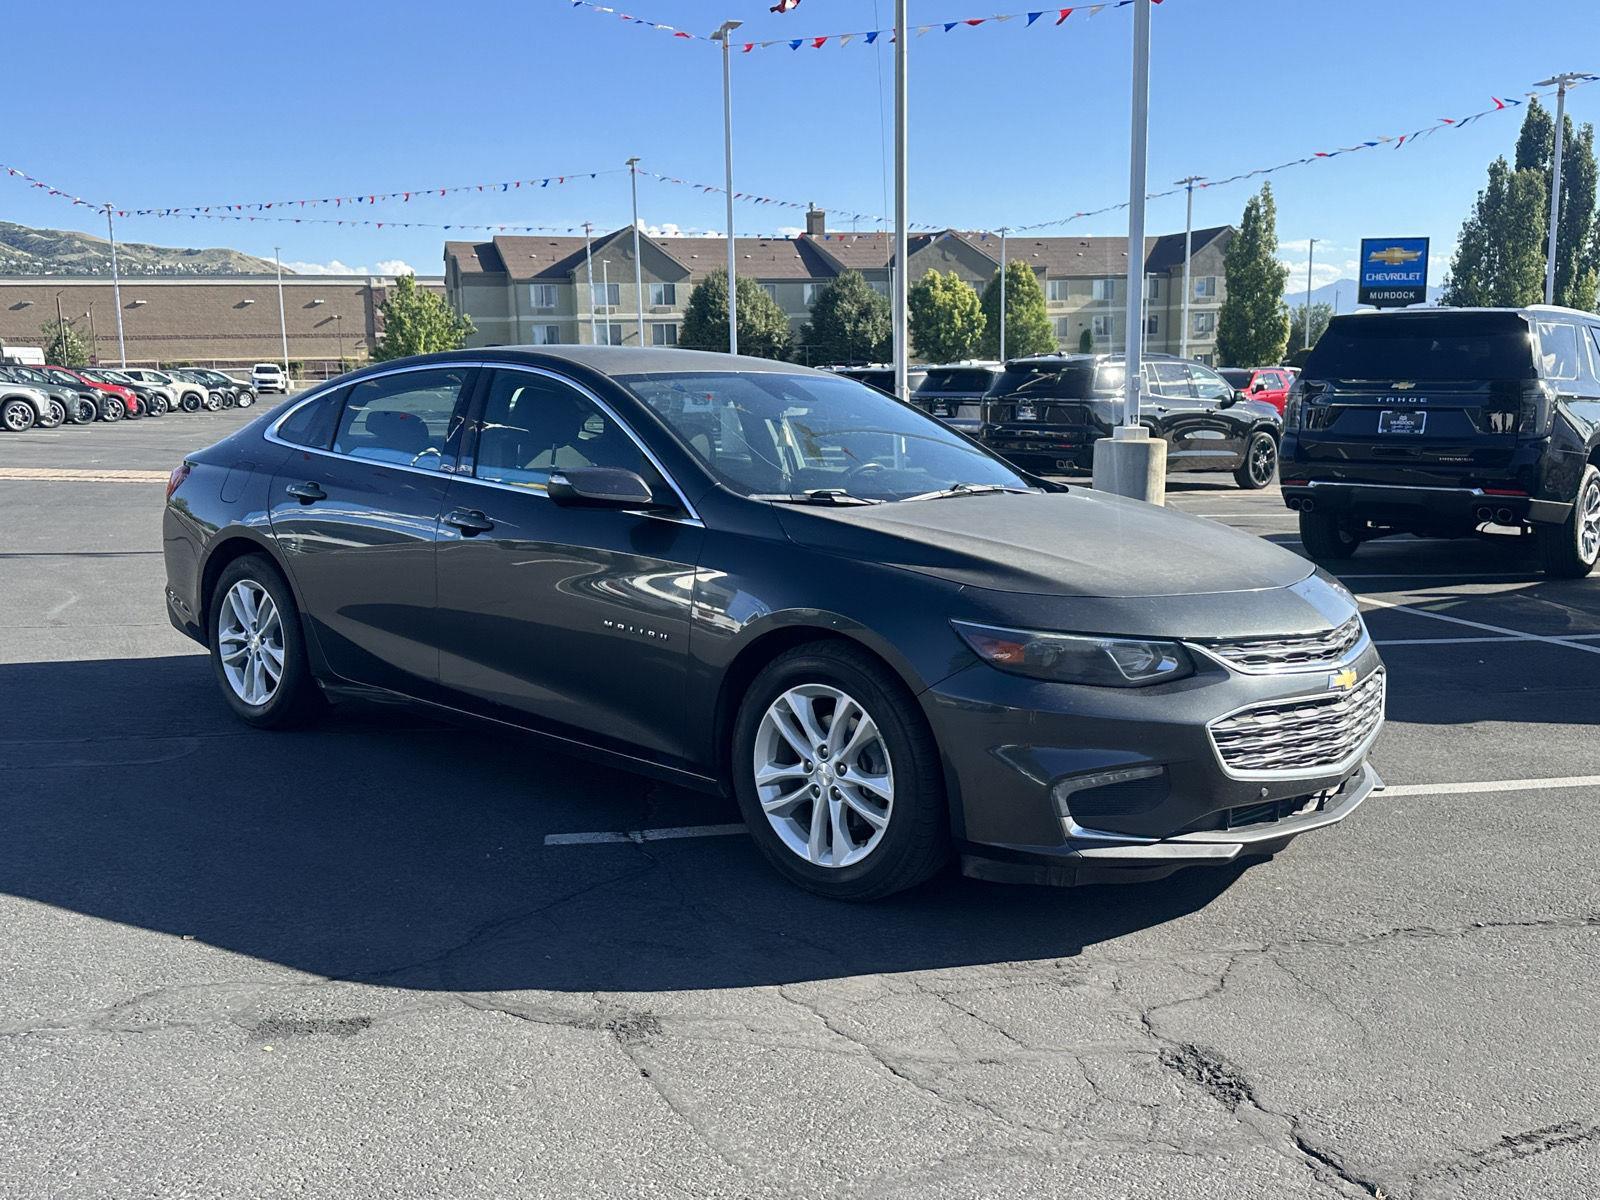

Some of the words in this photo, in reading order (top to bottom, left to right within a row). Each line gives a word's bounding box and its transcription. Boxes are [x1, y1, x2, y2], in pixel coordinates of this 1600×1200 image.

[1365, 272, 1421, 281] CHEVROLET
[1369, 291, 1415, 299] MURDOCK
[1130, 415, 1139, 424] 13
[603, 619, 669, 640] MALIBU
